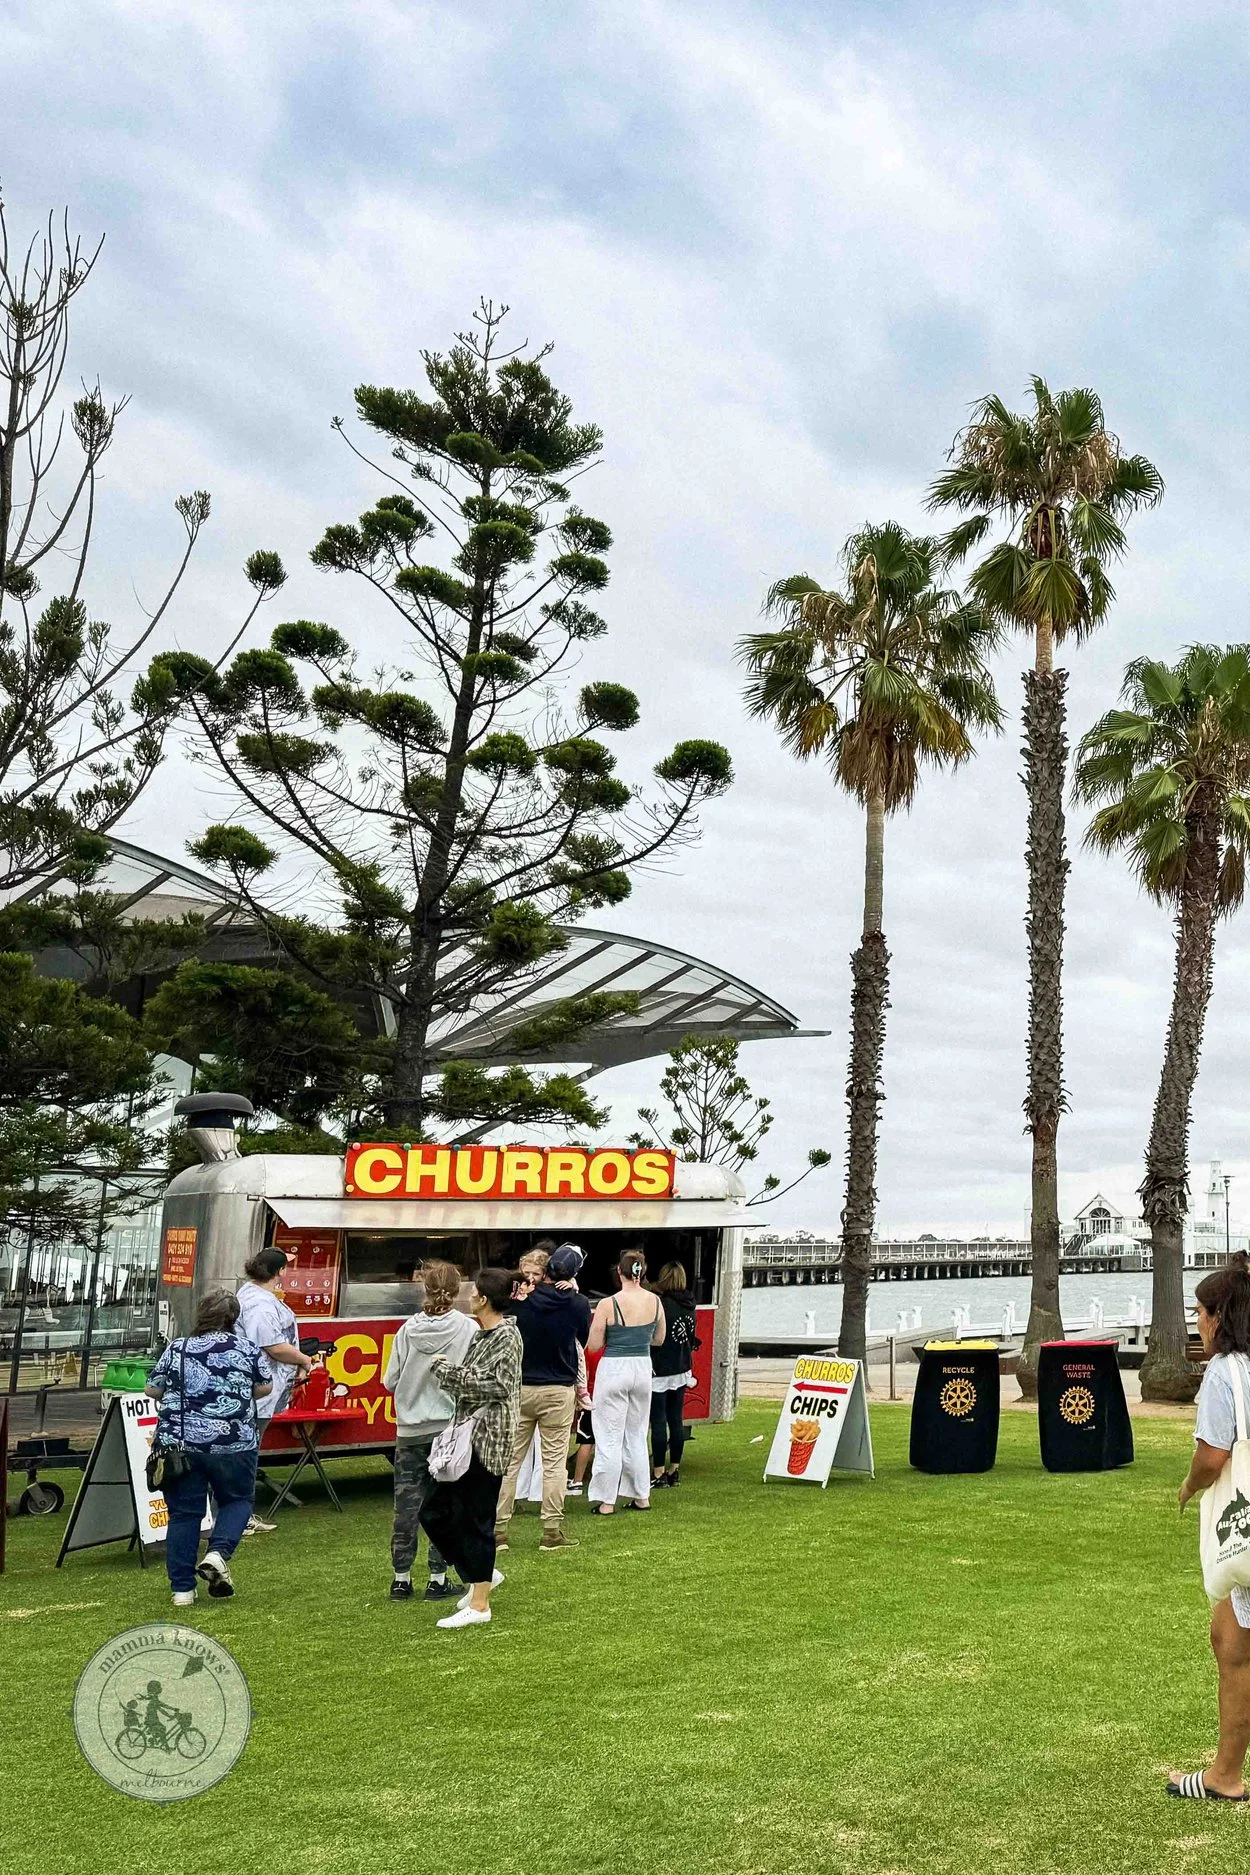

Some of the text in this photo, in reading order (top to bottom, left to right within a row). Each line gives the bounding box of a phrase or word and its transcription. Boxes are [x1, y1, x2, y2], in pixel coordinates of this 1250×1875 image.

[353, 1148, 670, 1195] CHURROS
[794, 1358, 856, 1384] CHURROS
[942, 1366, 975, 1374] RECYCLE
[1066, 1371, 1091, 1379] WASTE
[126, 1399, 150, 1417] HOT
[790, 1395, 839, 1418] CHIPS
